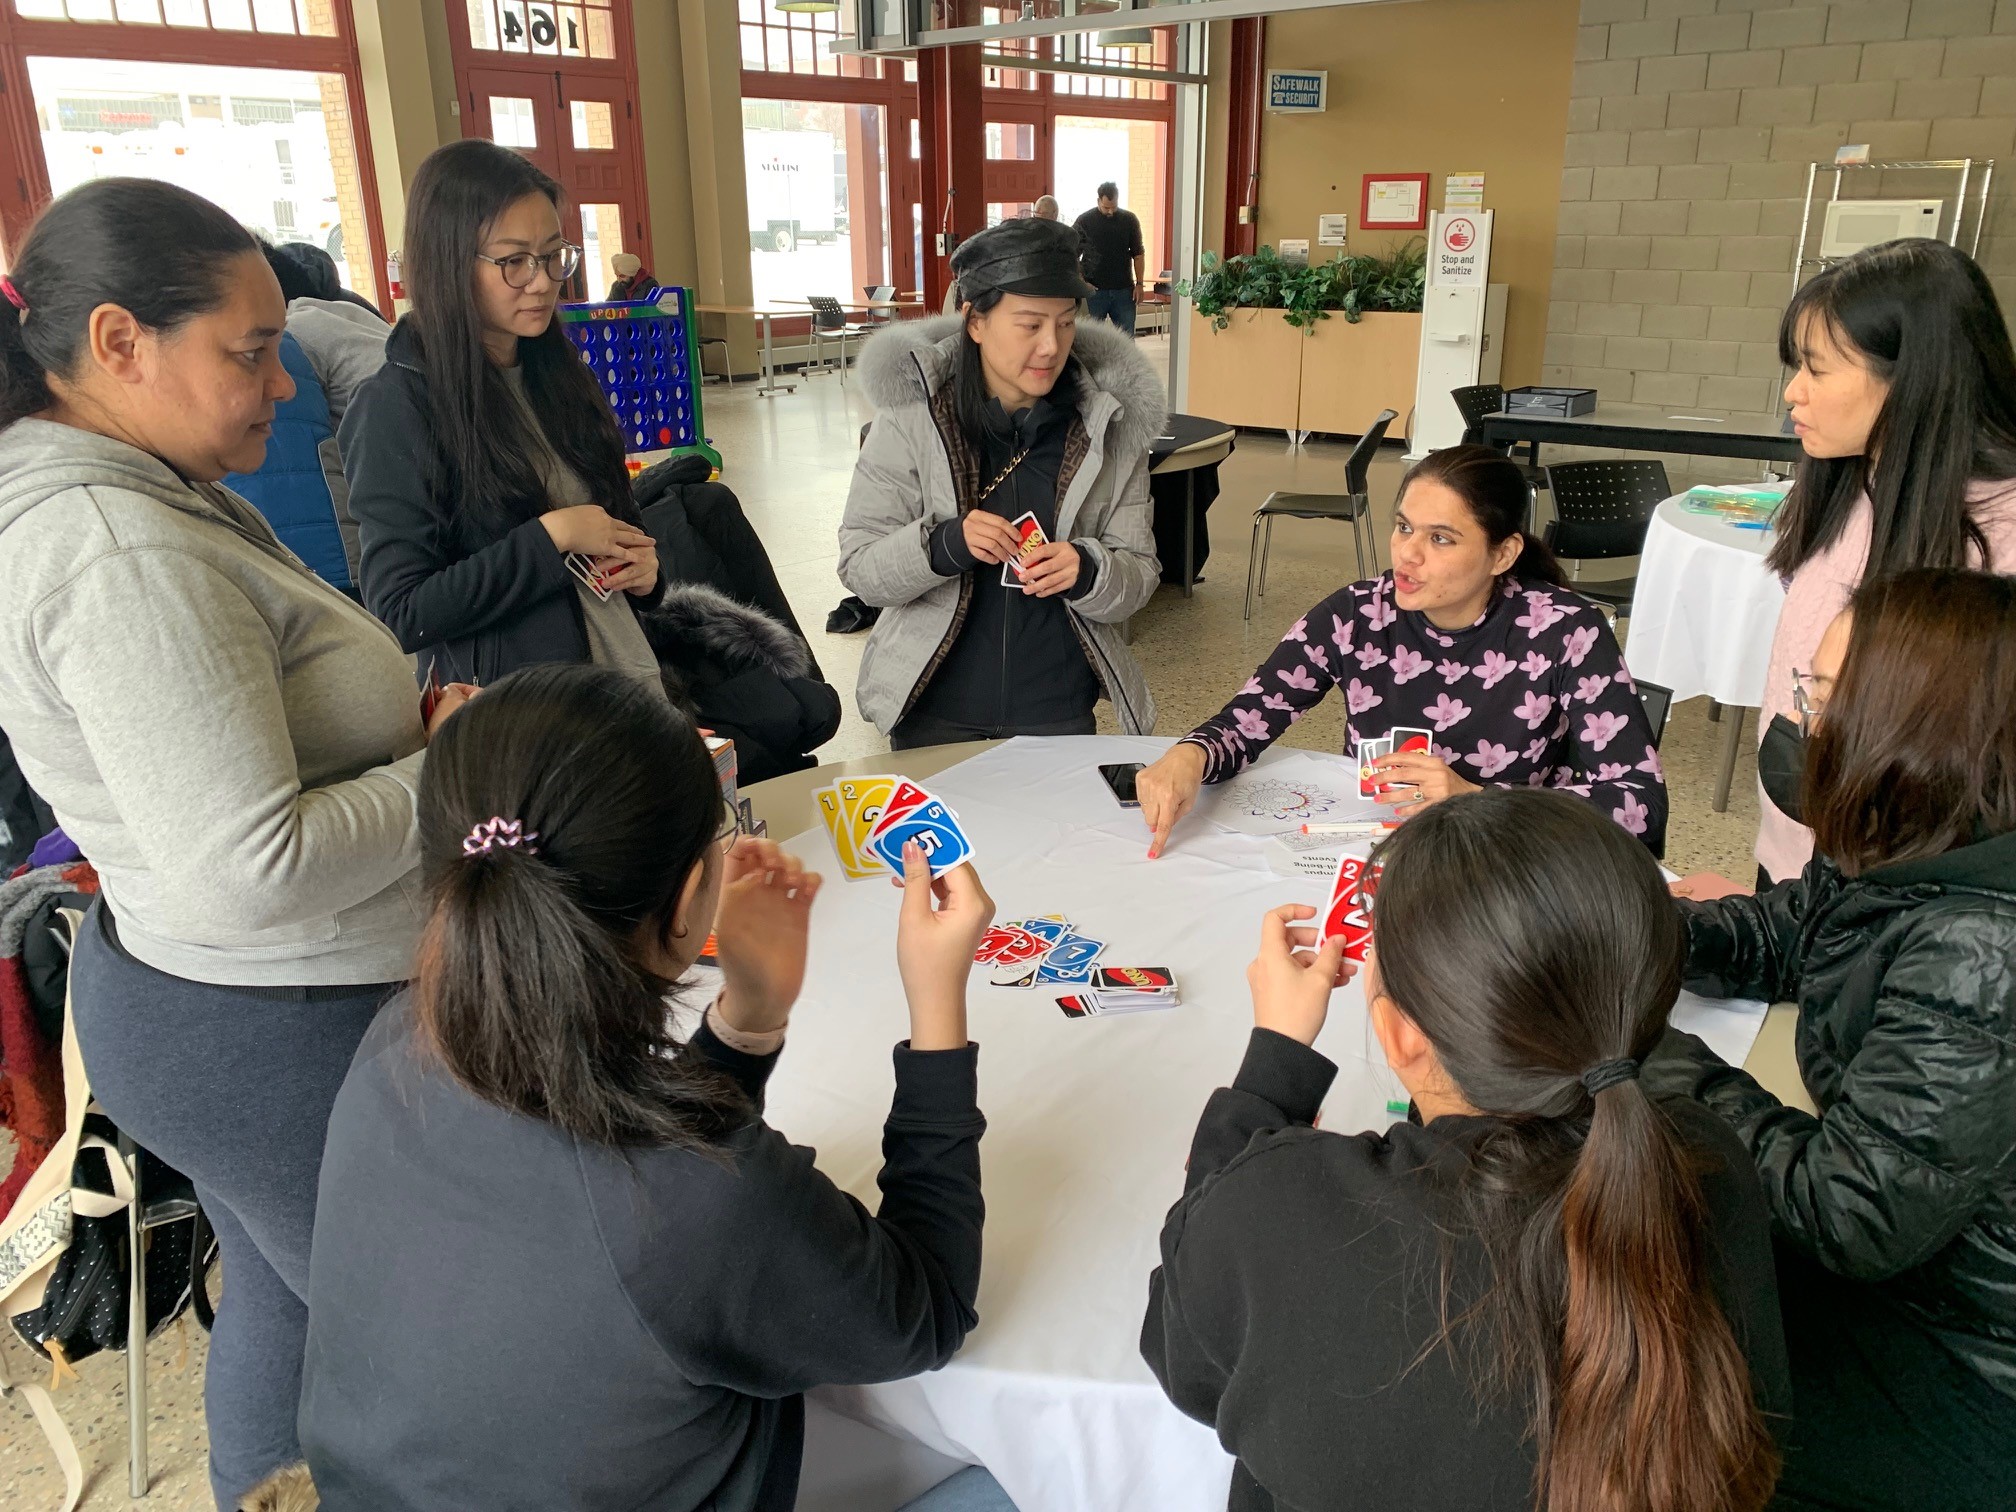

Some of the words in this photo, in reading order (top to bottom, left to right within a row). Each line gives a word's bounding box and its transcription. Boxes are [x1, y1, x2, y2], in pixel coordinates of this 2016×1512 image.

[1273, 75, 1319, 91] SAFEWALK
[1285, 92, 1319, 105] SECURITY
[1441, 254, 1458, 265] Stop
[1460, 255, 1475, 263] and
[1441, 265, 1472, 275] Sanitize
[843, 784, 858, 800] 2
[901, 785, 916, 801] 7
[822, 795, 834, 811] 1
[927, 805, 944, 819] 5
[907, 828, 944, 858] 5
[1342, 862, 1358, 880] 2
[1341, 892, 1375, 929] 2
[1067, 946, 1087, 959] 7
[1120, 967, 1153, 987] UNO
